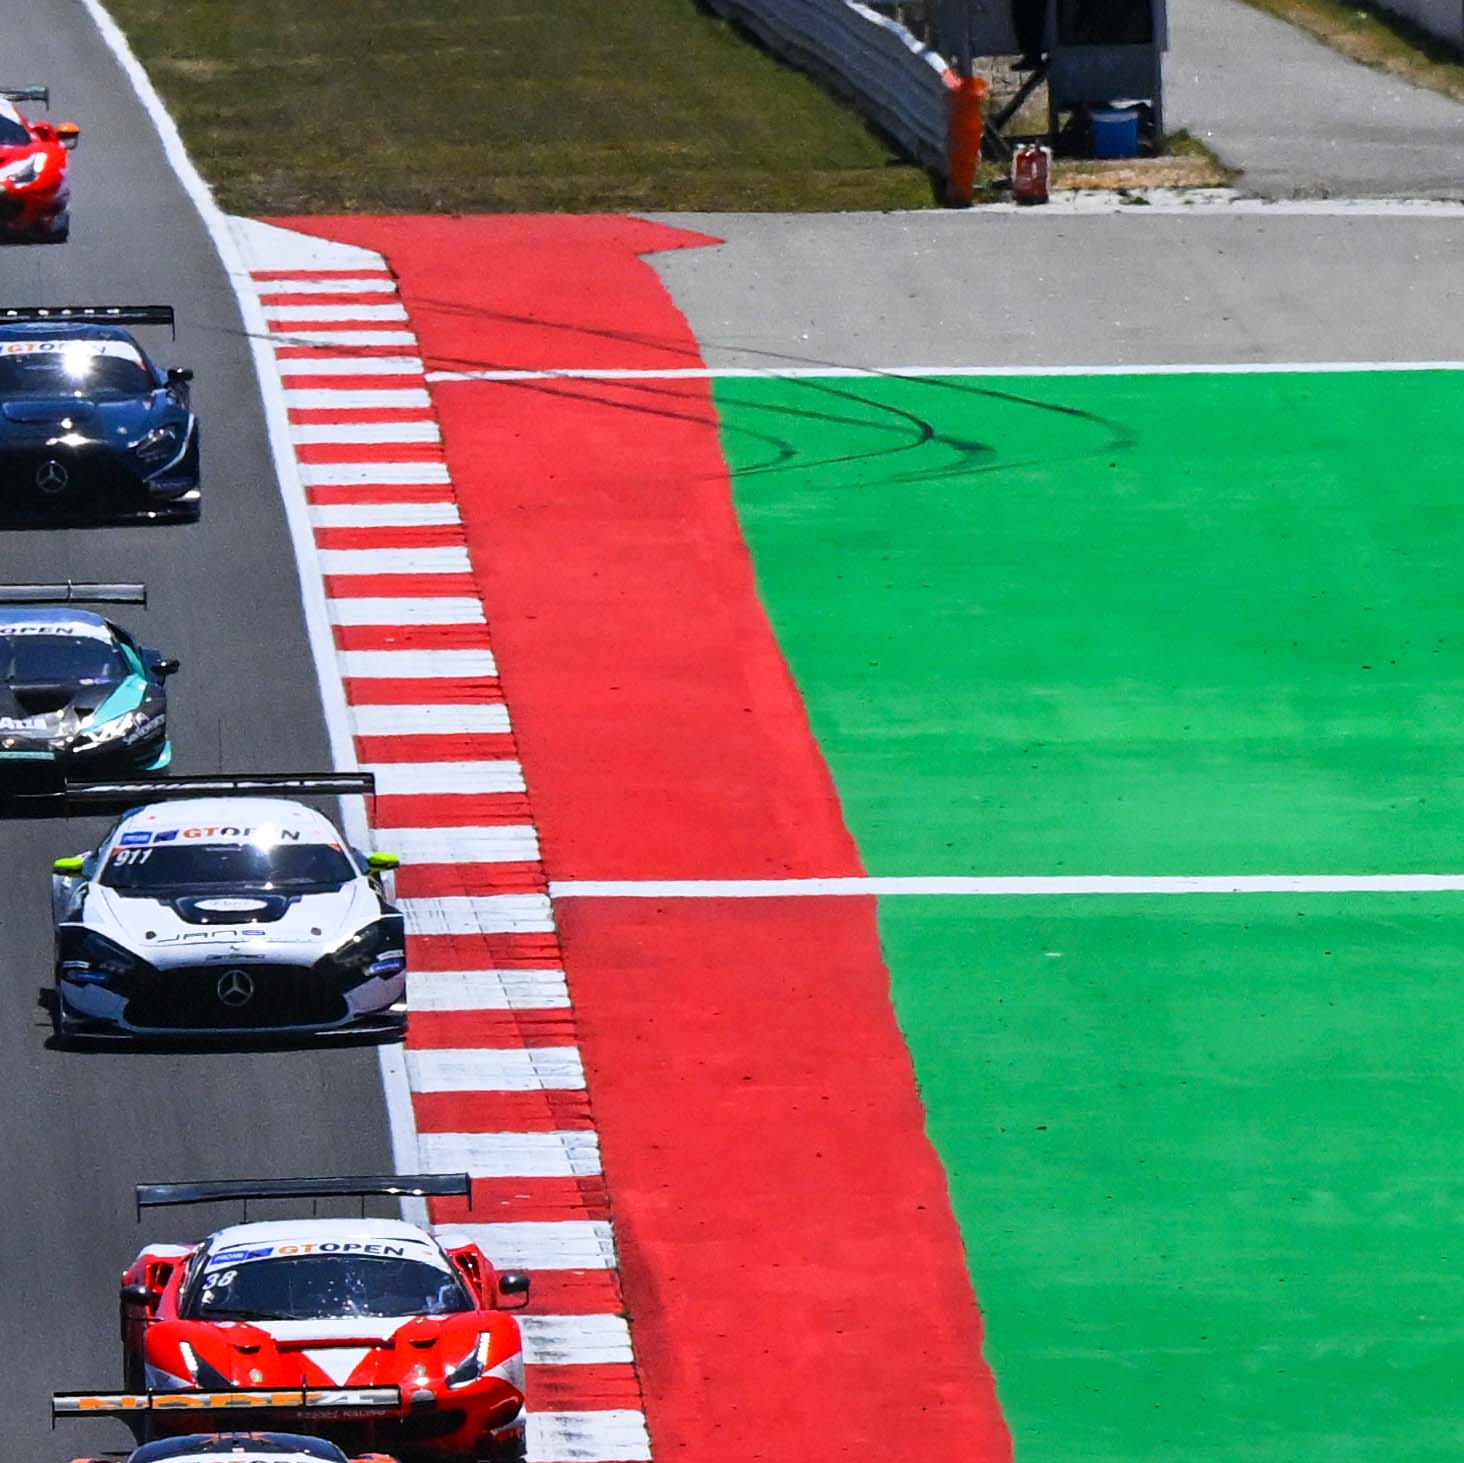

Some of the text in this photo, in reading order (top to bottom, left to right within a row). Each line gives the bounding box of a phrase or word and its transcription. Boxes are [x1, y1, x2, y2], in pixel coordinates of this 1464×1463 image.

[113, 848, 152, 868] 911
[278, 1242, 405, 1257] GTOPEN
[202, 1270, 238, 1289] 38
